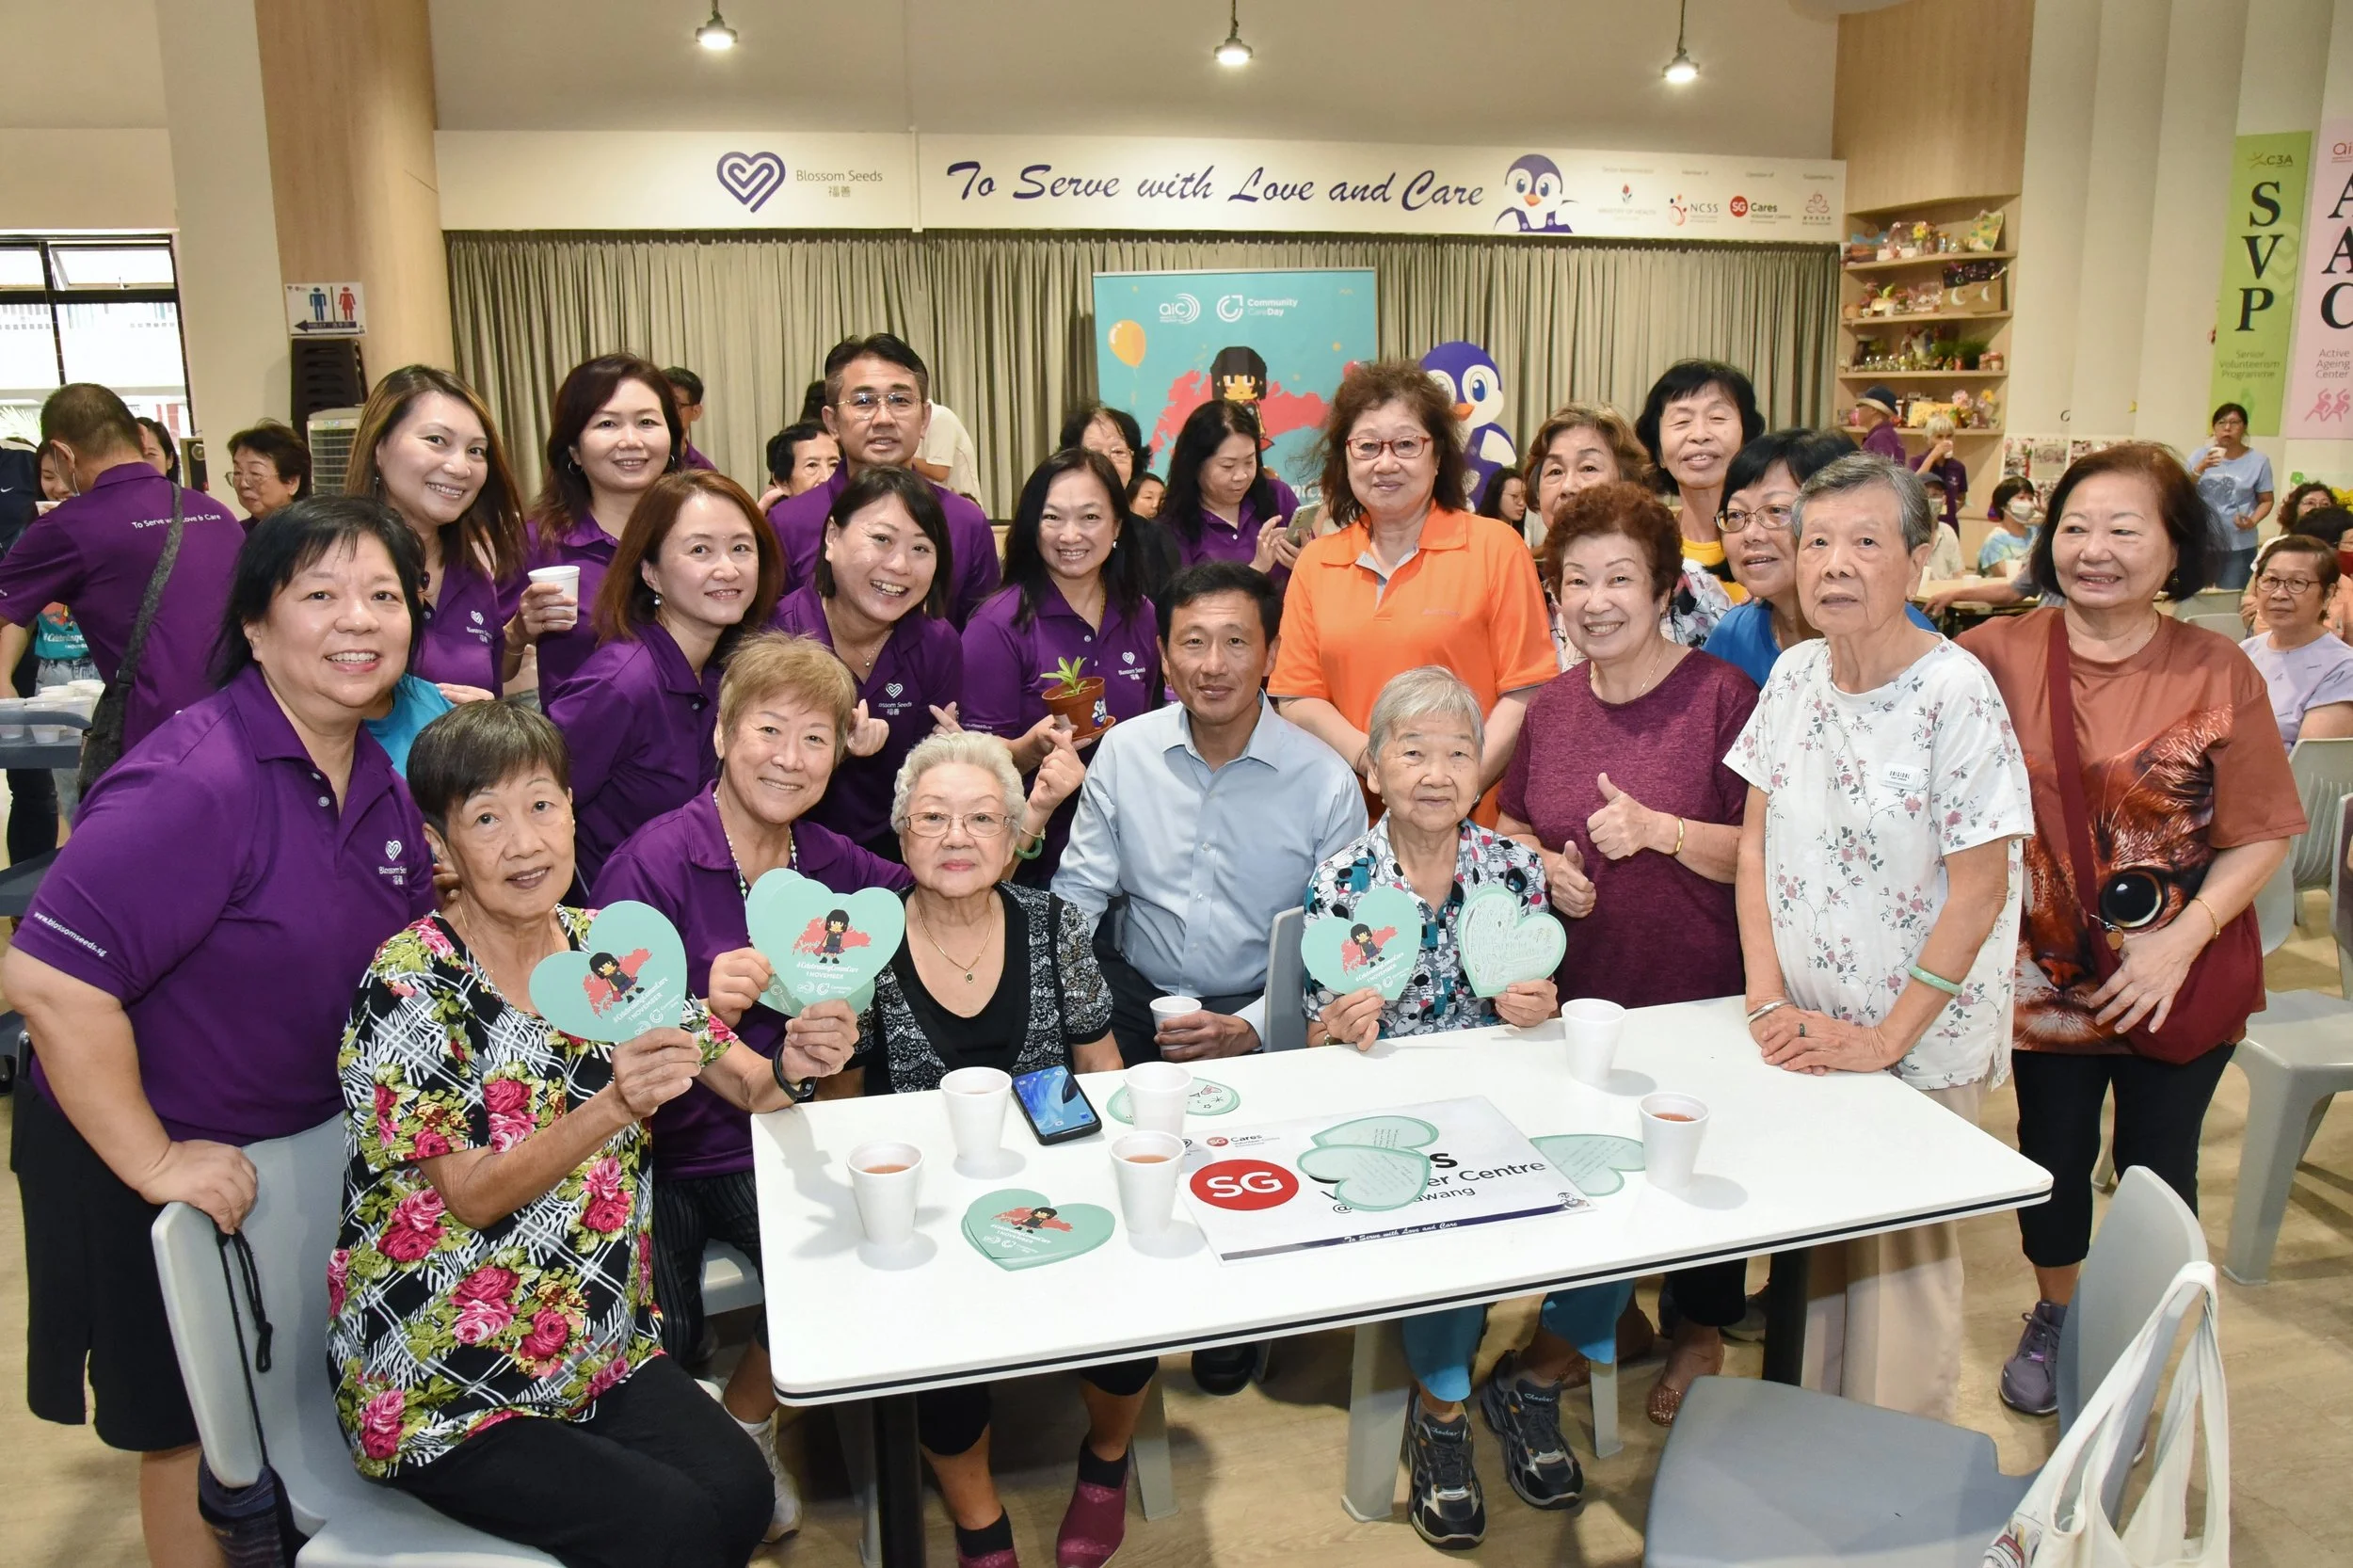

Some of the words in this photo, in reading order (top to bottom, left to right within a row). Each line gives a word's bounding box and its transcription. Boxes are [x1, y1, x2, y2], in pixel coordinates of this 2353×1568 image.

[2332, 142, 2353, 155] ai
[2266, 154, 2293, 167] C3A
[796, 170, 845, 182] Blossom
[848, 170, 883, 182] Seeds
[947, 161, 997, 200] To
[1012, 164, 1121, 200] Serve
[1136, 165, 1215, 200] with
[1227, 167, 1315, 202] Love
[1328, 171, 1396, 202] and
[1401, 169, 1484, 211] Care
[1689, 203, 1719, 213] NCSS
[1732, 201, 1747, 212] SG
[1751, 202, 1778, 213] Cares
[1247, 298, 1298, 308] Community
[2319, 349, 2350, 358] Active
[2316, 360, 2350, 370] Ageing
[144, 519, 165, 527] Serve
[34, 912, 107, 957] www.blossomseeds.sg
[1230, 1134, 1262, 1143] Cares
[1458, 1160, 1546, 1181] Centre
[1206, 1171, 1284, 1198] SG
[1383, 1229, 1400, 1238] with
